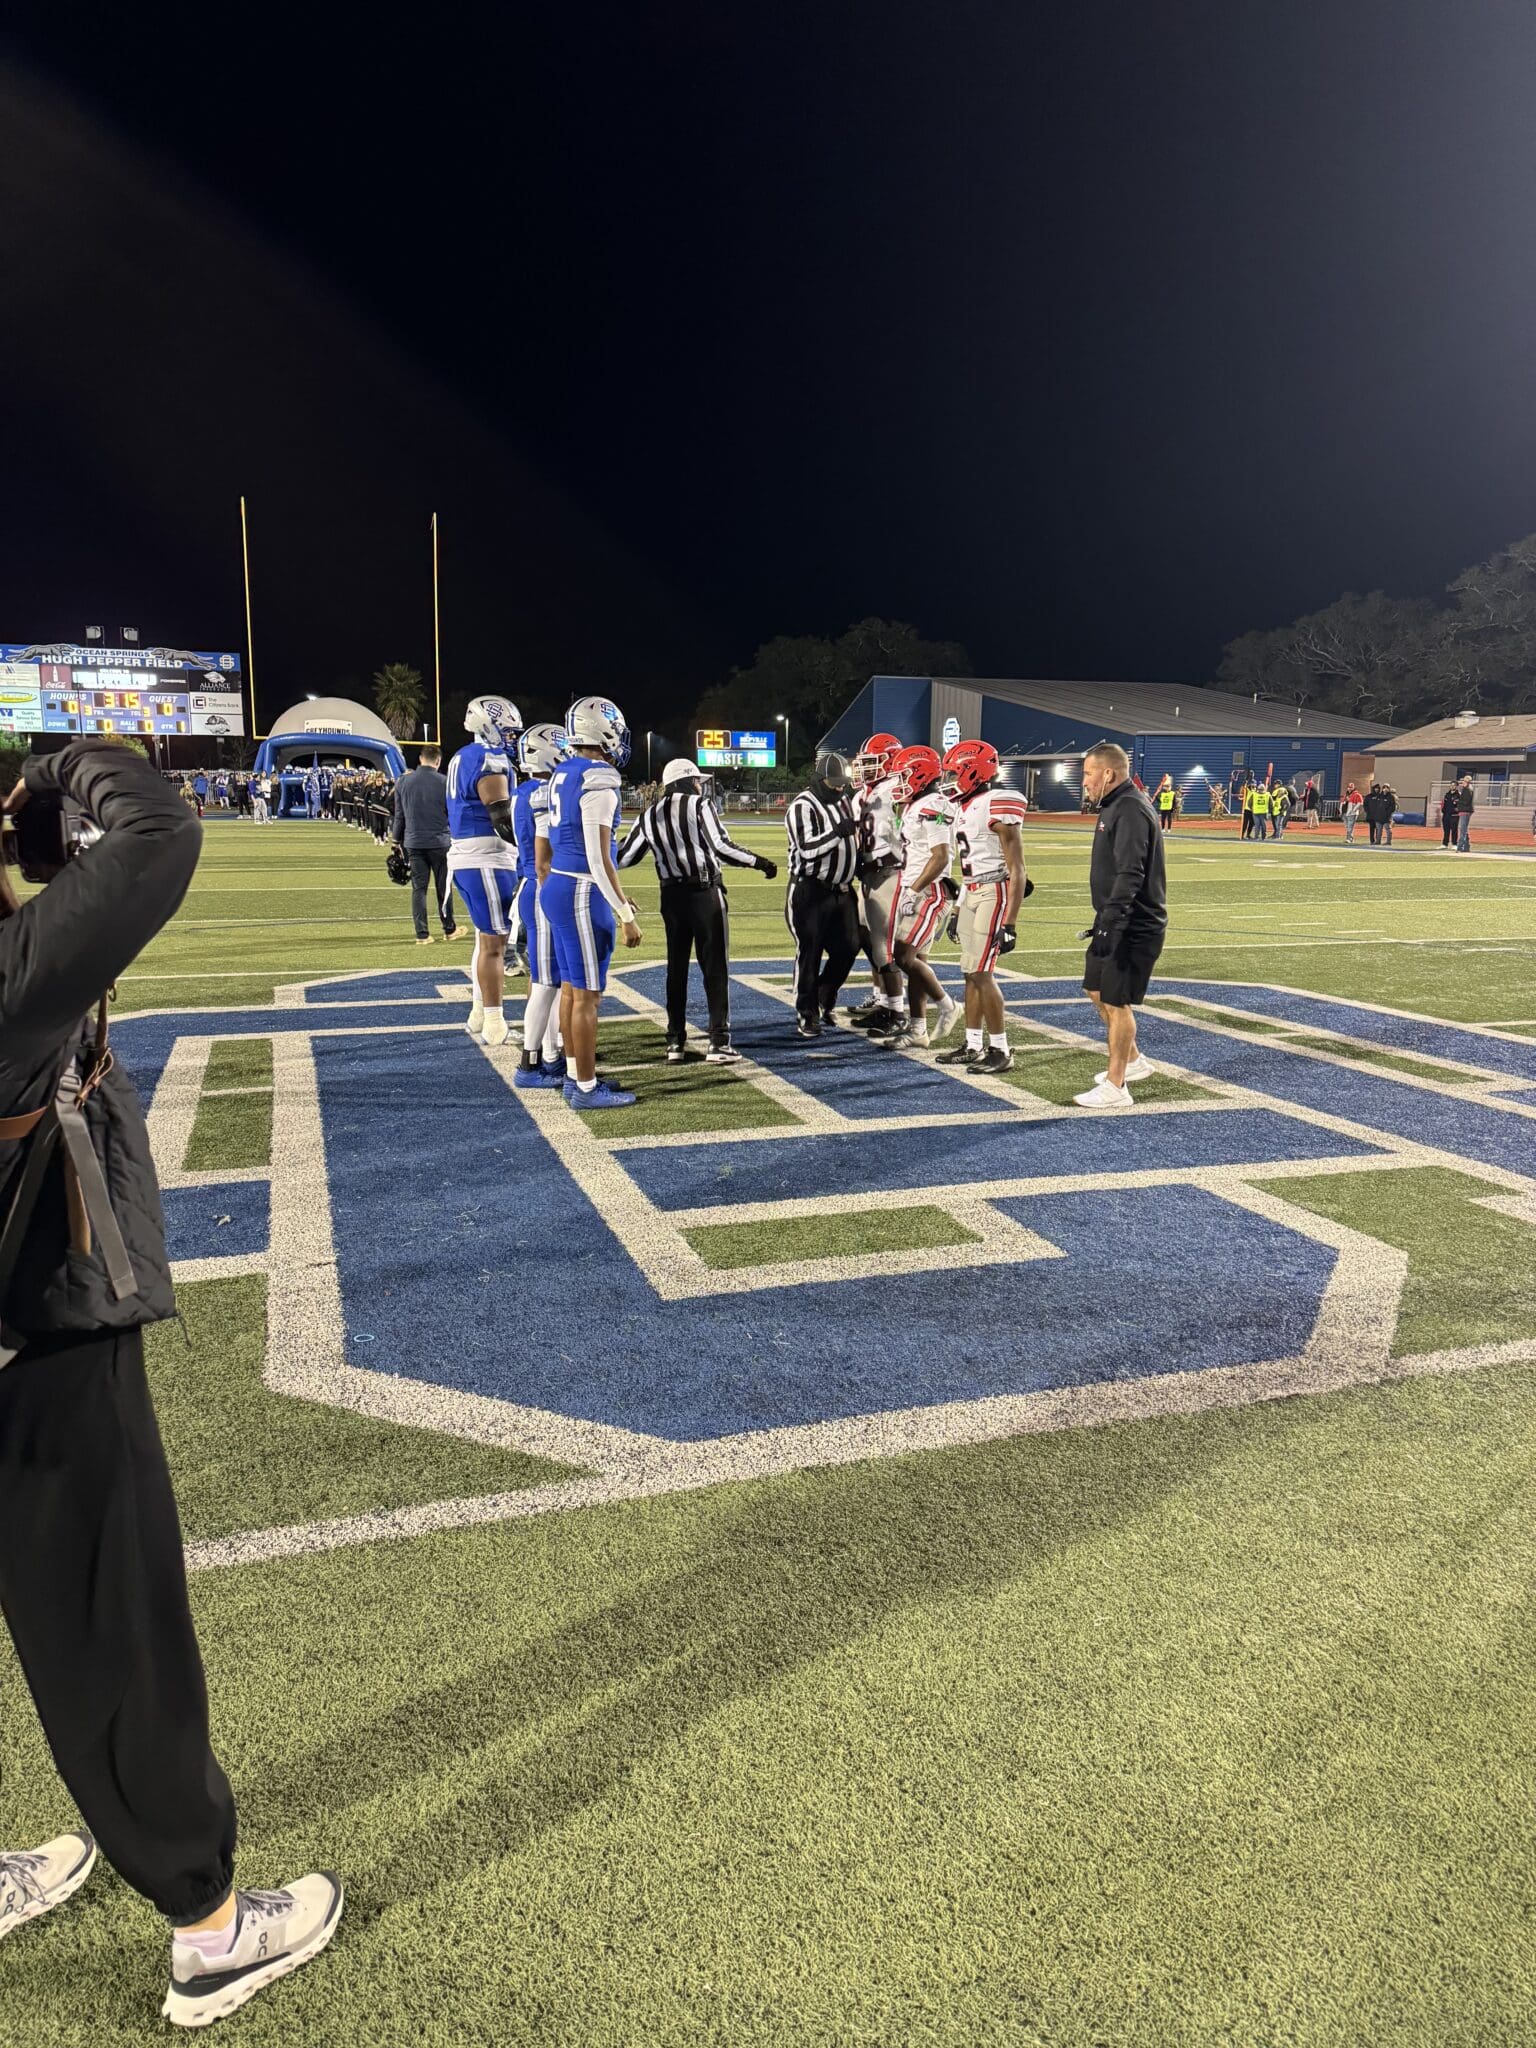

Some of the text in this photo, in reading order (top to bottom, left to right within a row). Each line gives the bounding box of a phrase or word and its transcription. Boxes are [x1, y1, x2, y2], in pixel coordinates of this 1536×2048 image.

[41, 655, 184, 668] HUGH PEPPER FIELD
[68, 701, 78, 714] 0
[163, 703, 173, 716] 0
[104, 719, 113, 731] 0
[145, 720, 154, 732] 0
[704, 730, 724, 749] 25
[706, 752, 744, 765] WASTE
